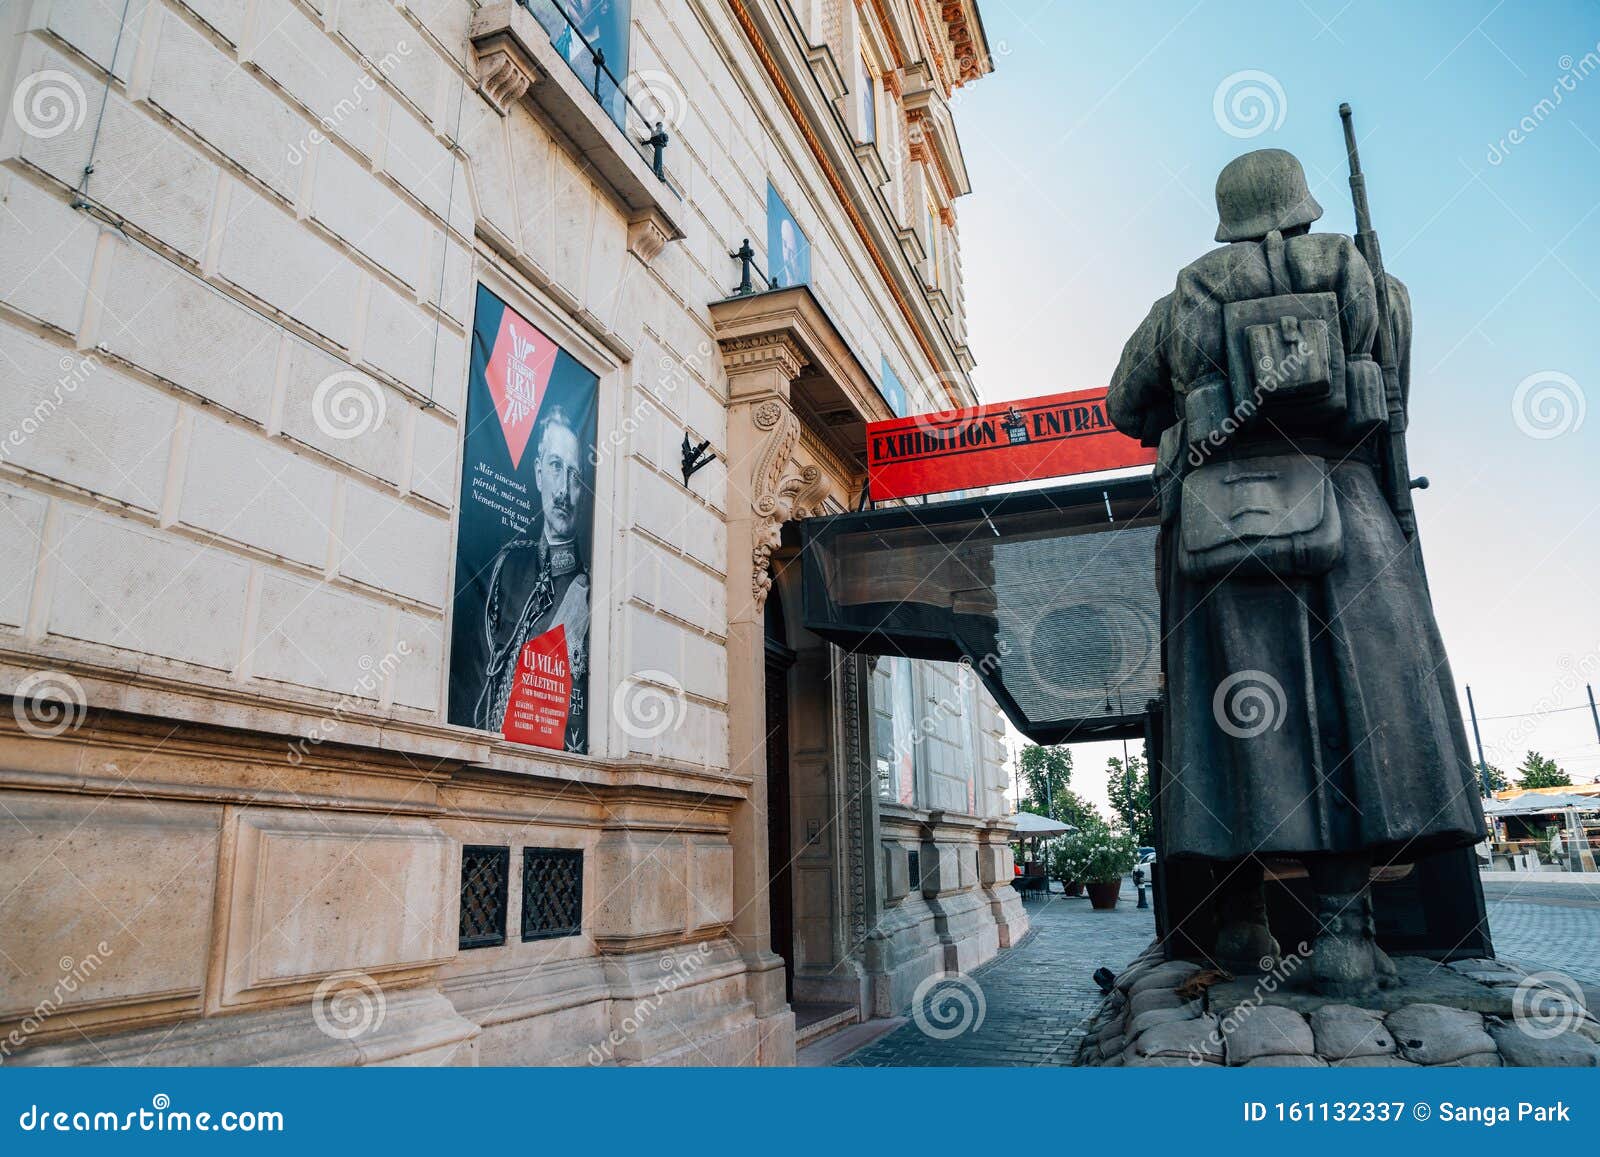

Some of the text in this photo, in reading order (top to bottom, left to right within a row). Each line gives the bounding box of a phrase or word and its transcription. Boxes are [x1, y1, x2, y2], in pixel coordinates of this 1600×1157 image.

[872, 420, 996, 461] EXHIBITION
[494, 472, 527, 494] nincsenek
[472, 490, 516, 519] Németország
[524, 644, 565, 678] ÚJ VILÁG
[521, 672, 558, 692] SZÜLETETT
